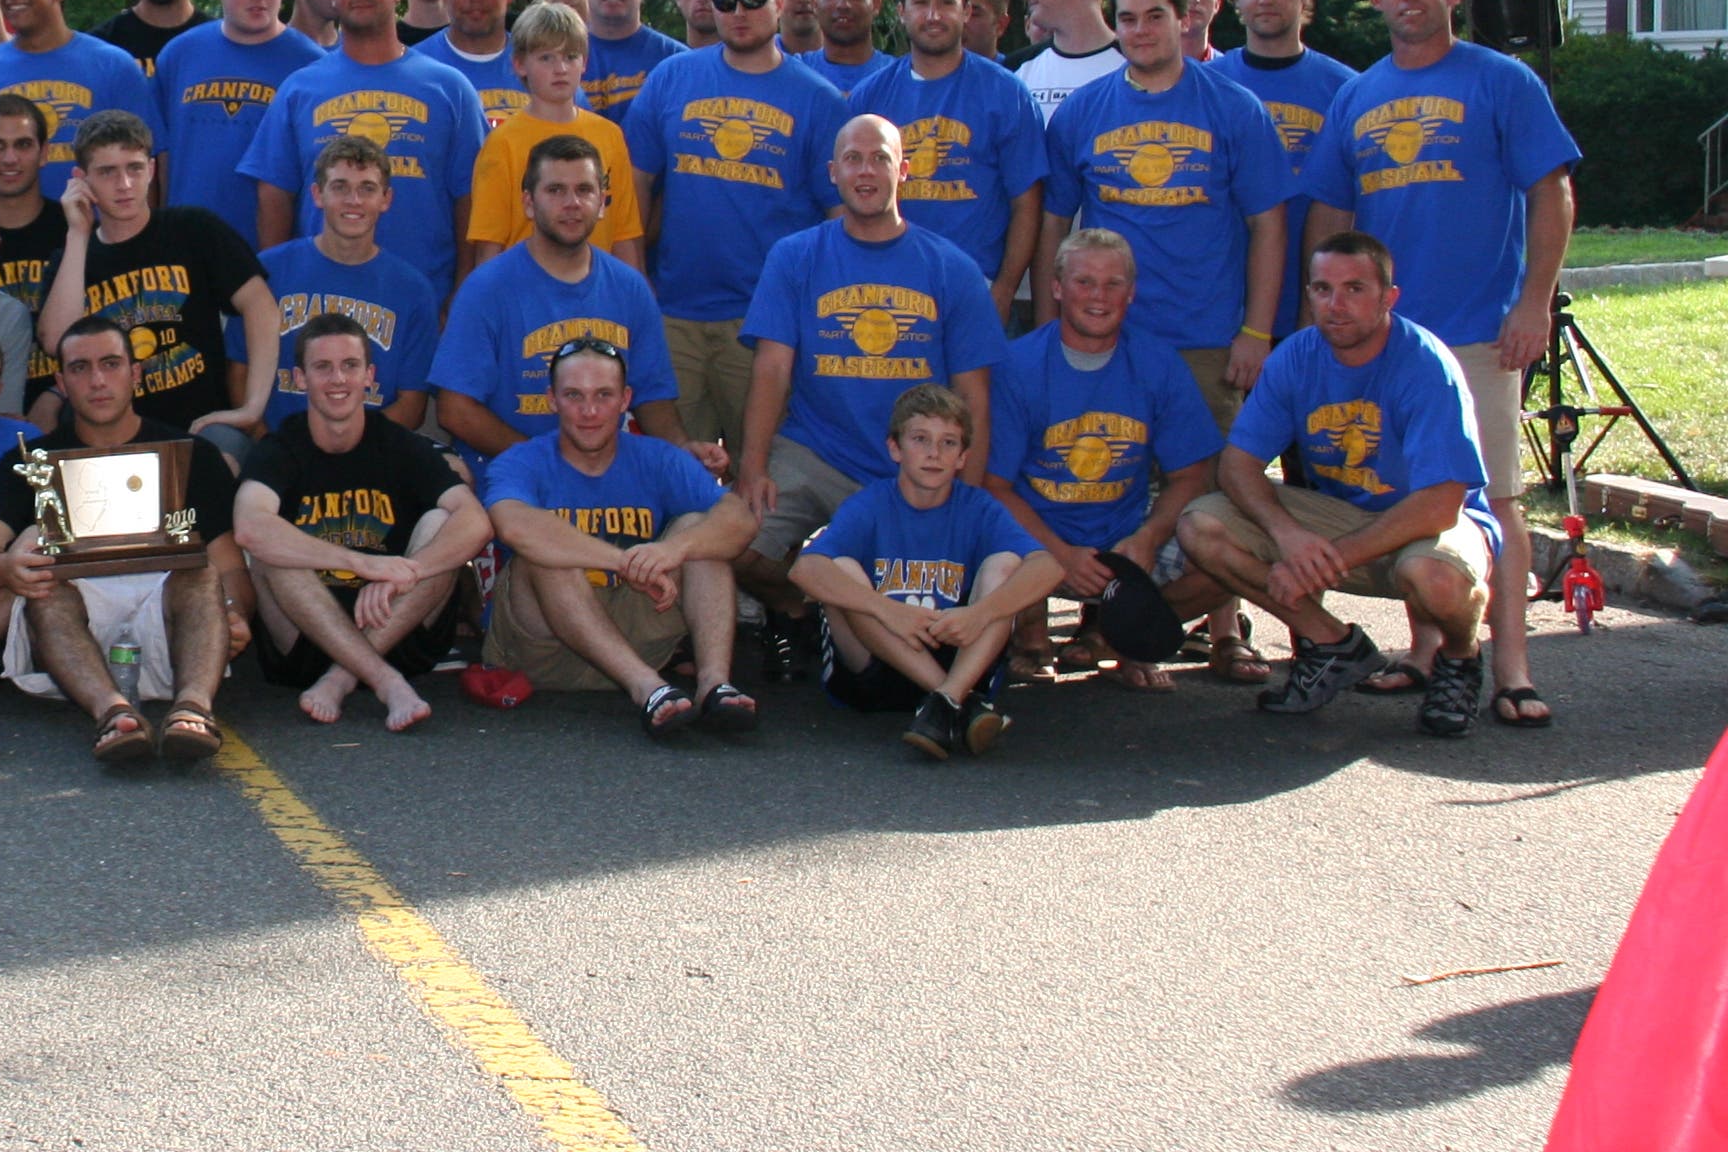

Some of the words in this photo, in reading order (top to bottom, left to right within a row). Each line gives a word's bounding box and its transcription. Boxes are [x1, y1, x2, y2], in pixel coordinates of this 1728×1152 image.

[182, 80, 278, 104] CRANFOR
[313, 89, 429, 127] CRANFORD
[682, 96, 795, 138] CRANFORD
[1354, 95, 1466, 141] CRANFORD
[1093, 120, 1213, 156] CRANFORD
[278, 293, 397, 352] CRANFORD
[816, 283, 939, 323] CRANFORD
[158, 328, 177, 346] 10
[523, 317, 630, 359] CRANFORD
[145, 352, 206, 393] CHAMPS
[813, 354, 934, 380] BASEBALL
[164, 507, 197, 530] 2010
